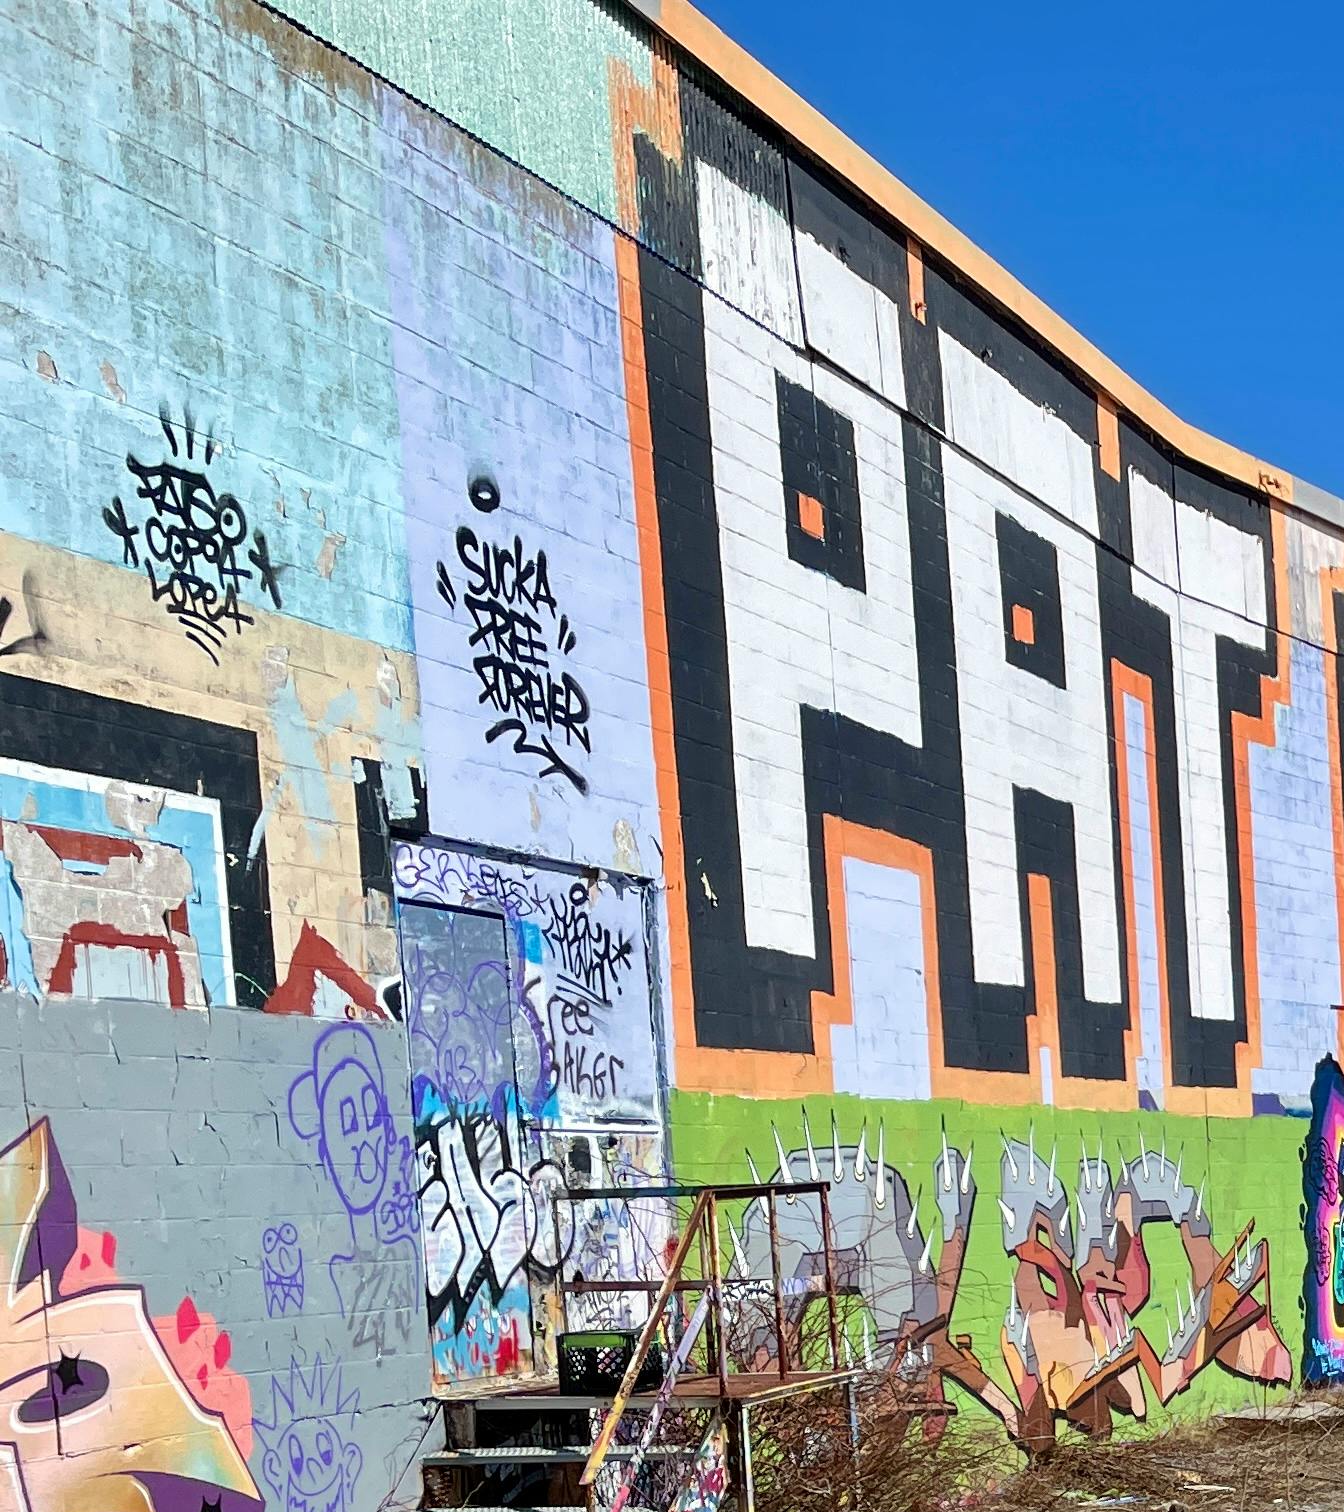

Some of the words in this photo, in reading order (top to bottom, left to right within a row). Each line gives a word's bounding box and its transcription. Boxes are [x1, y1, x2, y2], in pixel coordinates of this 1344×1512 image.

[456, 526, 557, 619] SUCKA
[693, 156, 1267, 1021] PAT
[464, 593, 549, 668] FREE
